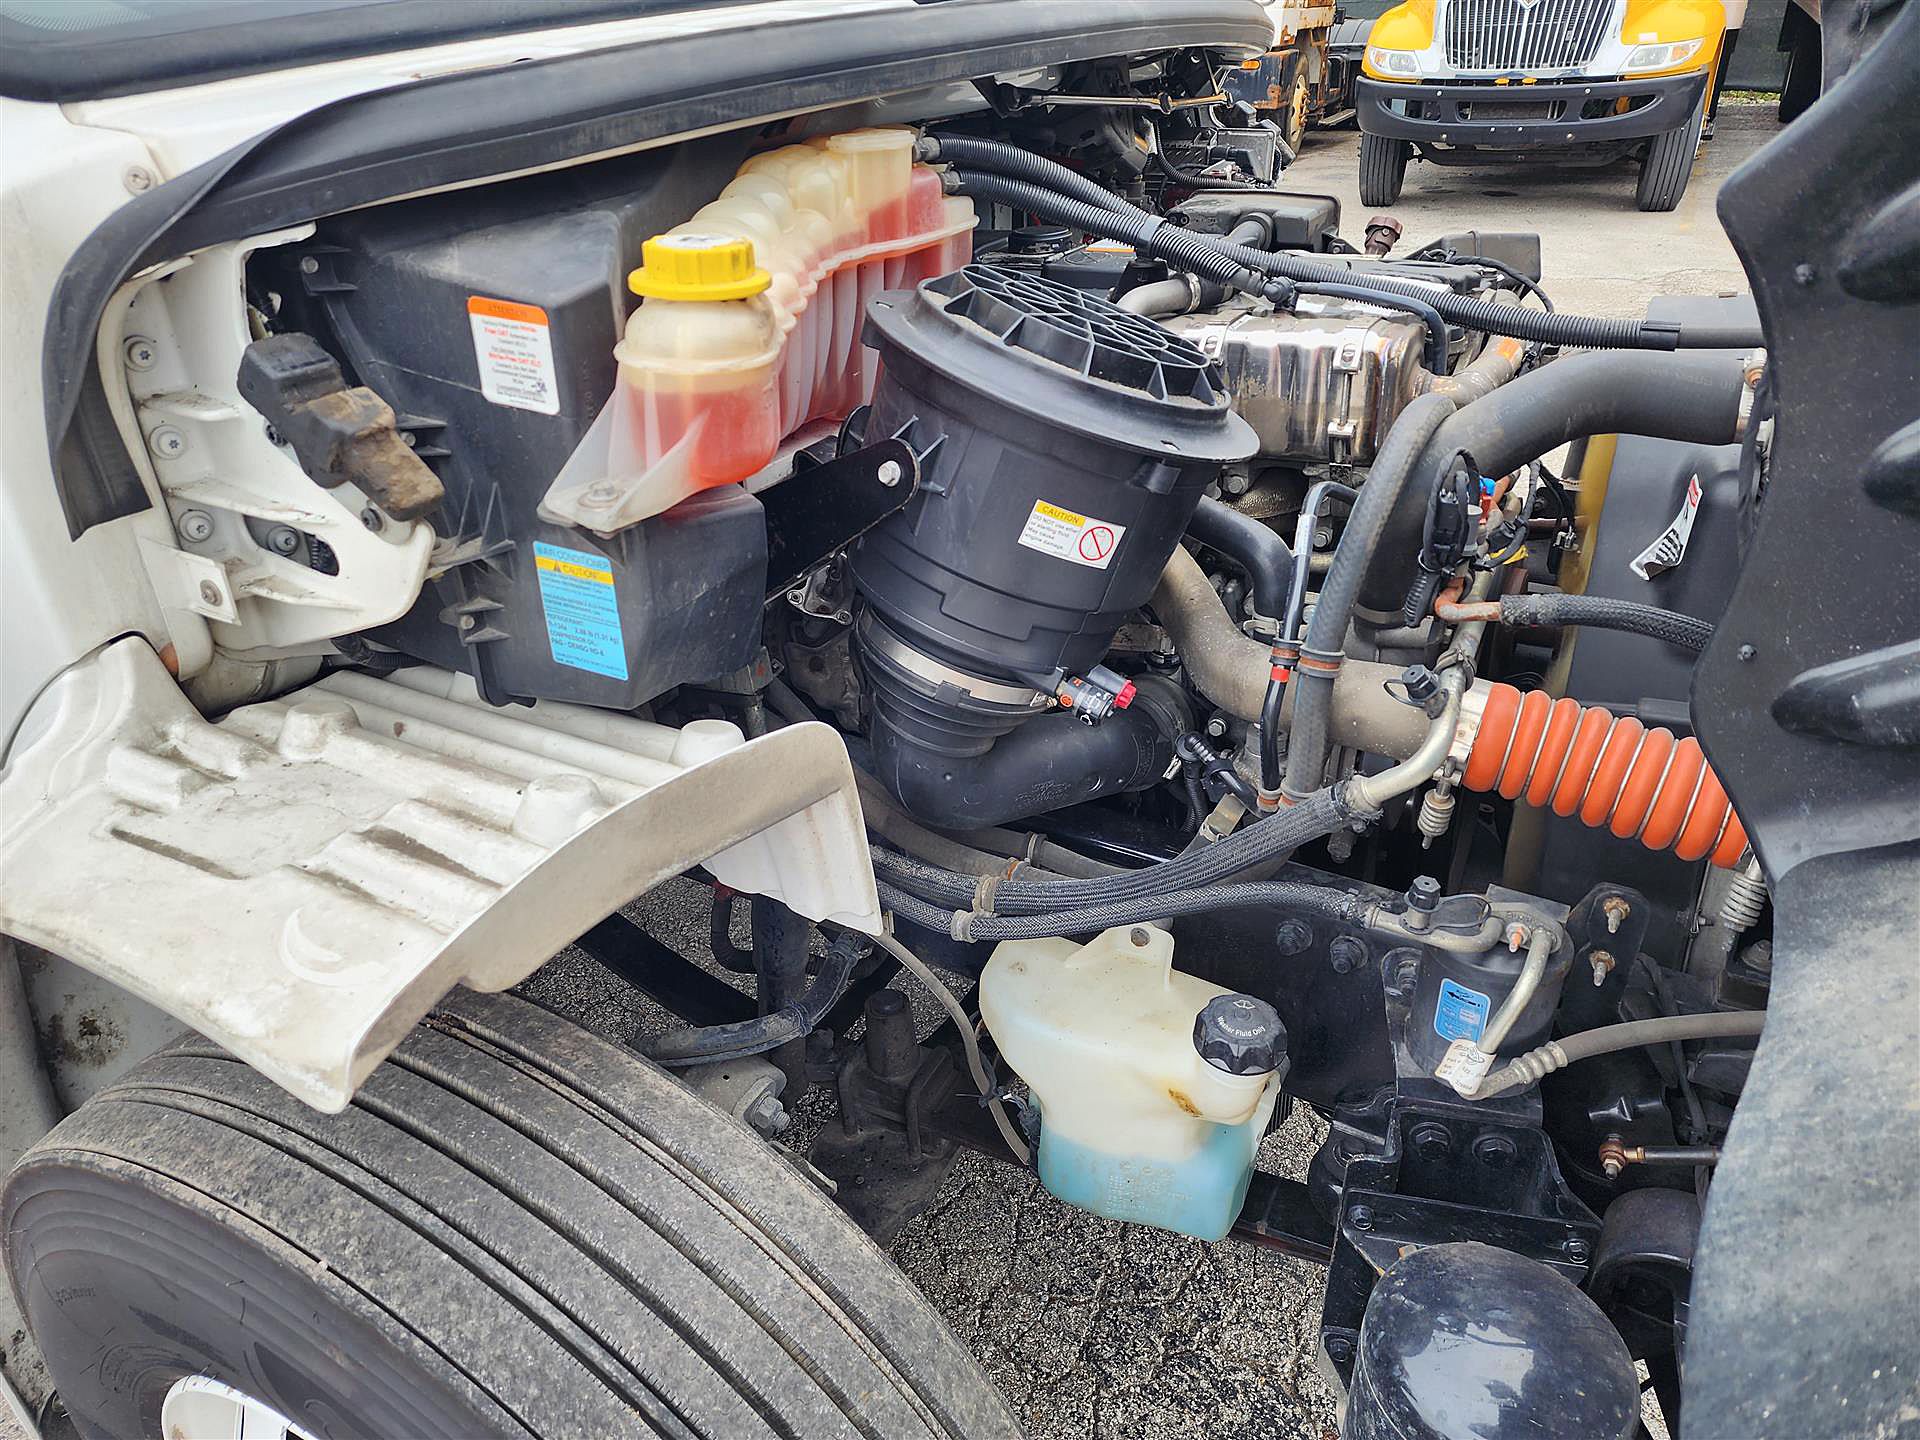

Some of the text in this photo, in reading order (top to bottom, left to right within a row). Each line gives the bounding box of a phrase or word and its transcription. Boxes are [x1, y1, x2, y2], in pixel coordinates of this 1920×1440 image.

[1042, 504, 1080, 525] CAUTION
[1042, 516, 1055, 526] NOT
[1235, 1028, 1252, 1037] Fluid
[1252, 1025, 1266, 1036] Only
